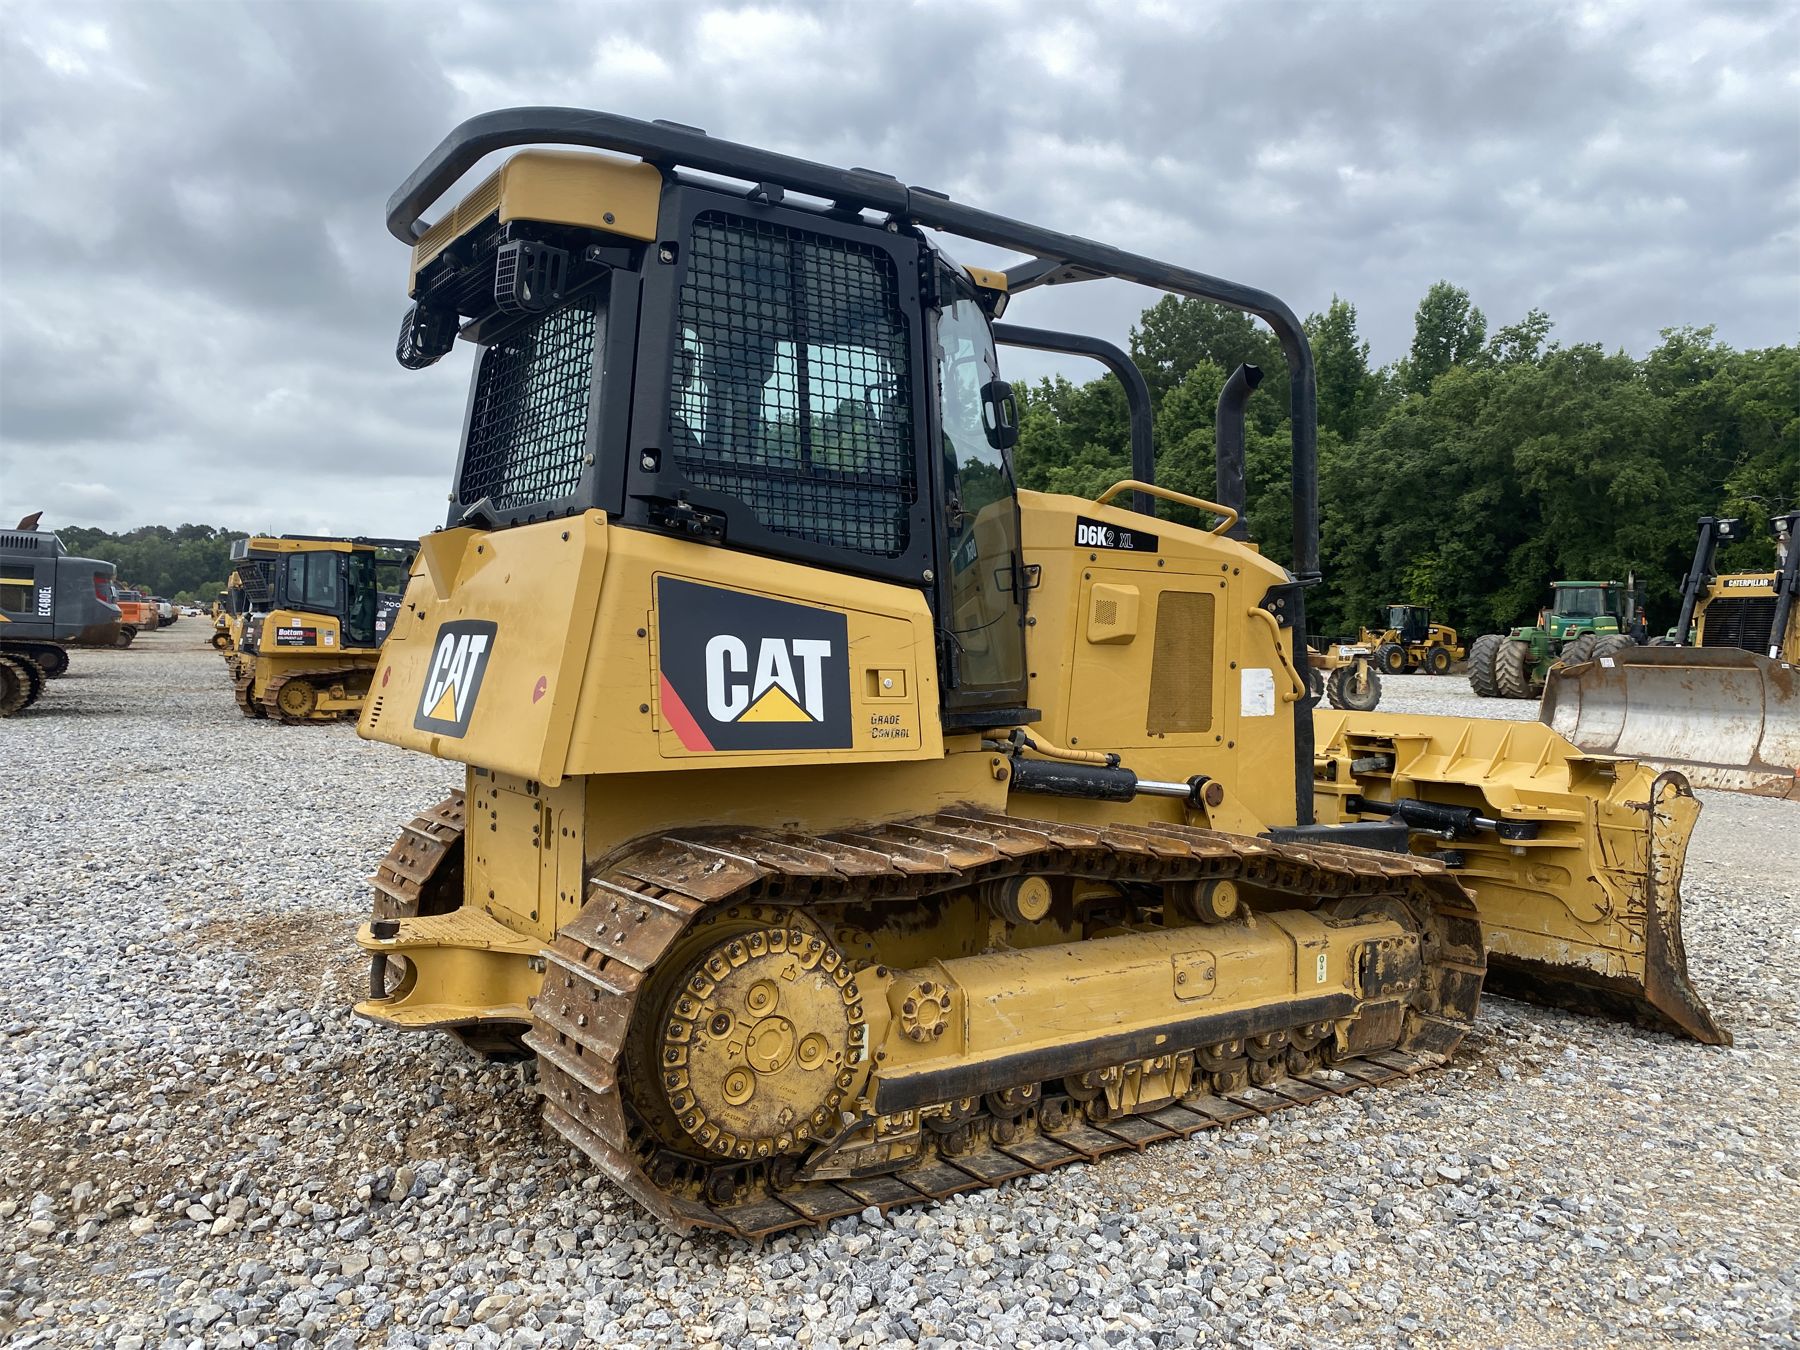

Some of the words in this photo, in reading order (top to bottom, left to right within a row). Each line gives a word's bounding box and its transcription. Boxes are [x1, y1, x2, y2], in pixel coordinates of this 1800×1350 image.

[1078, 524, 1115, 547] D6K2
[1119, 532, 1134, 549] XL
[1728, 579, 1769, 587] CATERPILLAR
[38, 586, 52, 616] EC480EL
[278, 628, 303, 636] Bottom
[422, 632, 489, 723] CAT
[705, 634, 832, 723] CAT
[871, 713, 900, 725] GRADE
[871, 727, 910, 739] CONTROL
